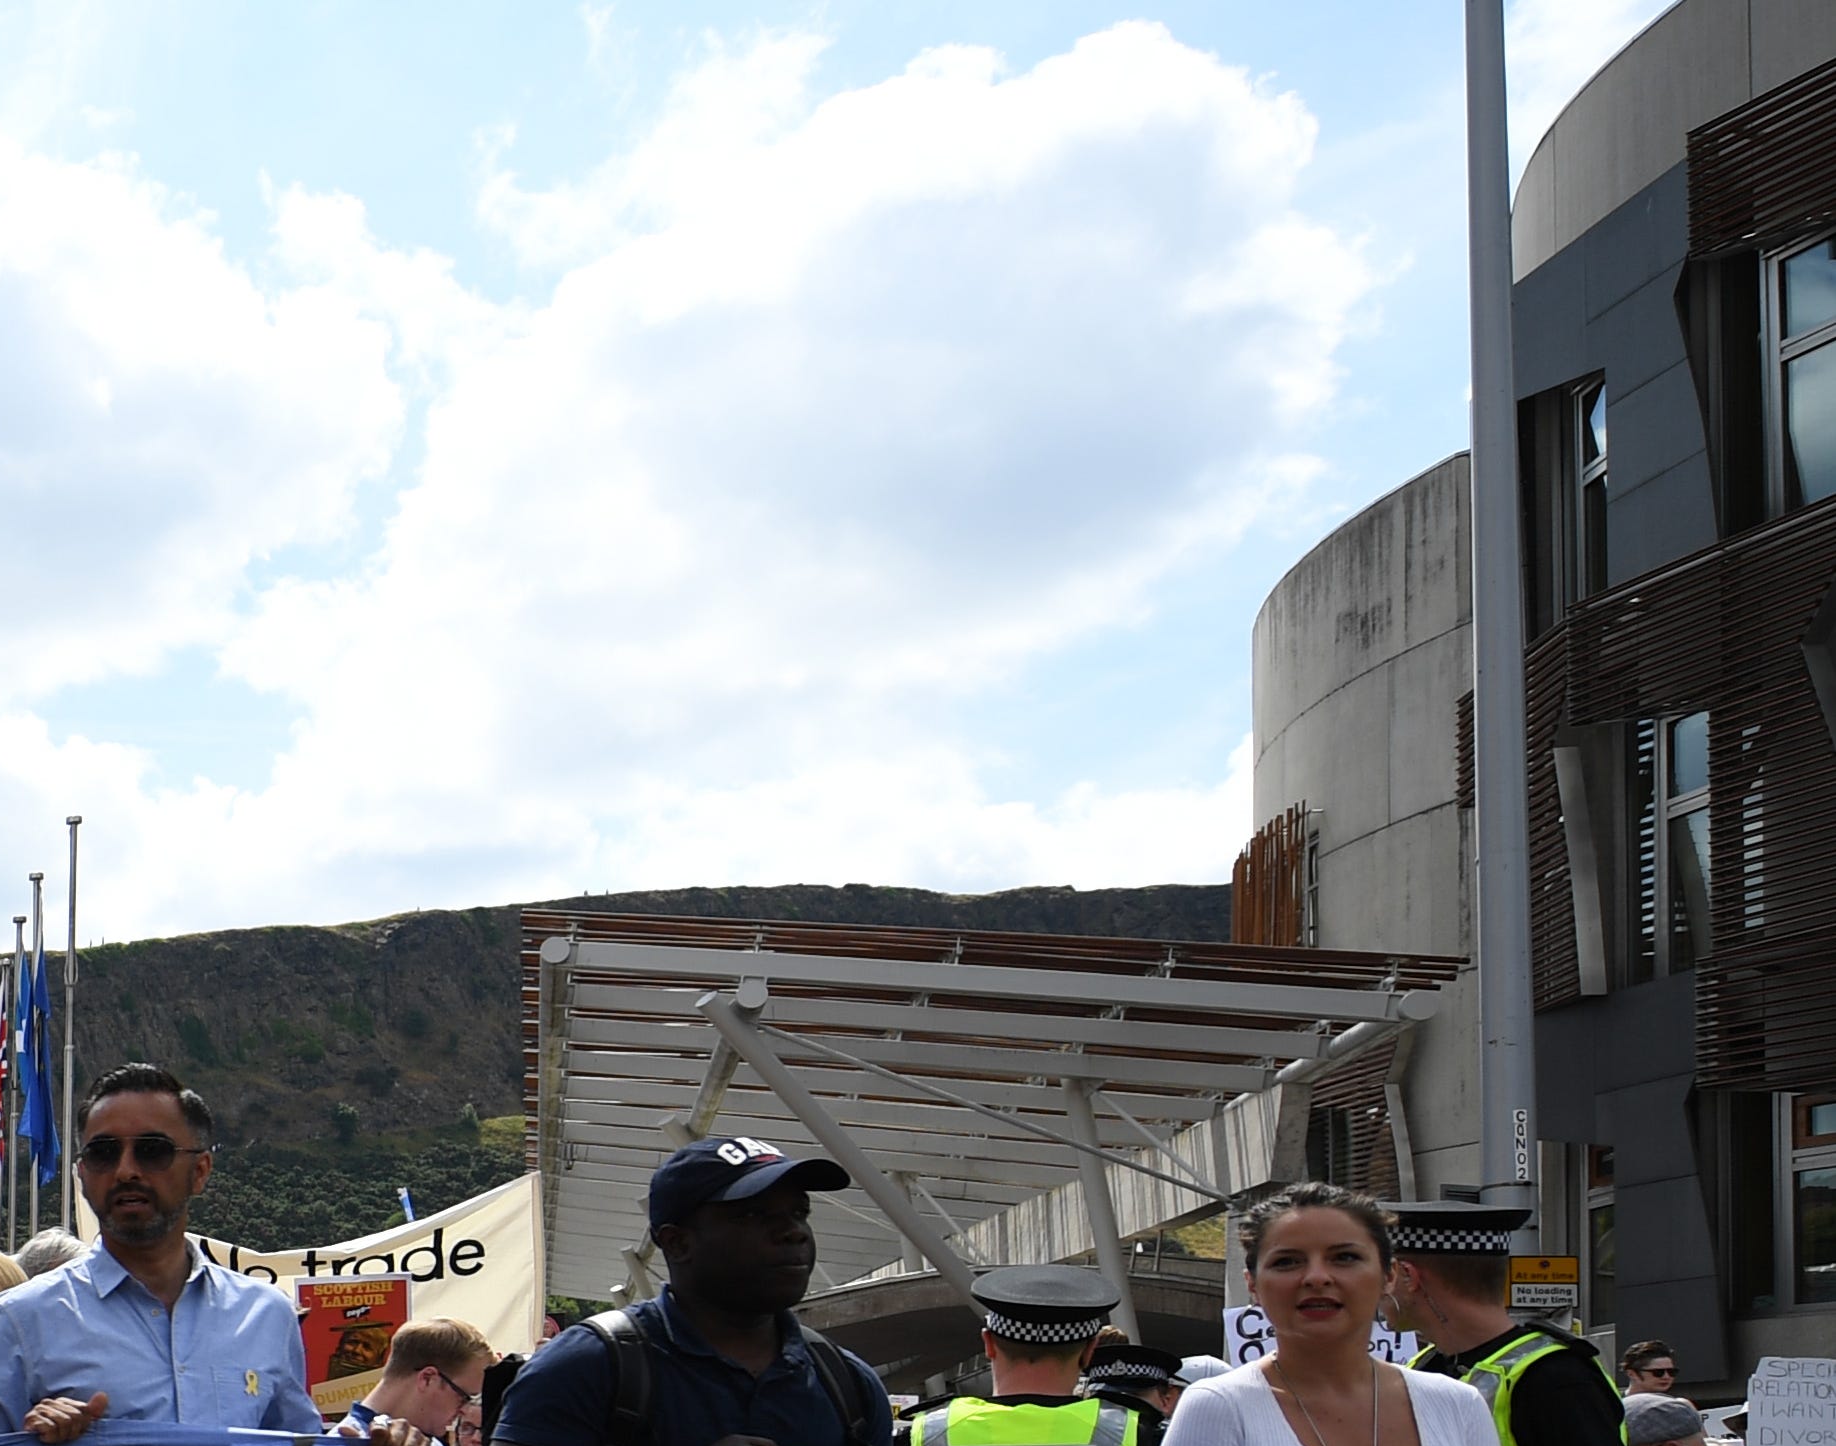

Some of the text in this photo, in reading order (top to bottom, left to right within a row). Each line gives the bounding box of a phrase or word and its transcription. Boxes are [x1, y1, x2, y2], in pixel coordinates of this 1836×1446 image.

[716, 1136, 785, 1166] GA
[302, 1228, 486, 1283] trade
[313, 1281, 395, 1296] SCOTTISH
[1516, 1286, 1573, 1297] No loading
[320, 1293, 387, 1308] LABOUR
[1767, 1360, 1836, 1378] SPECI
